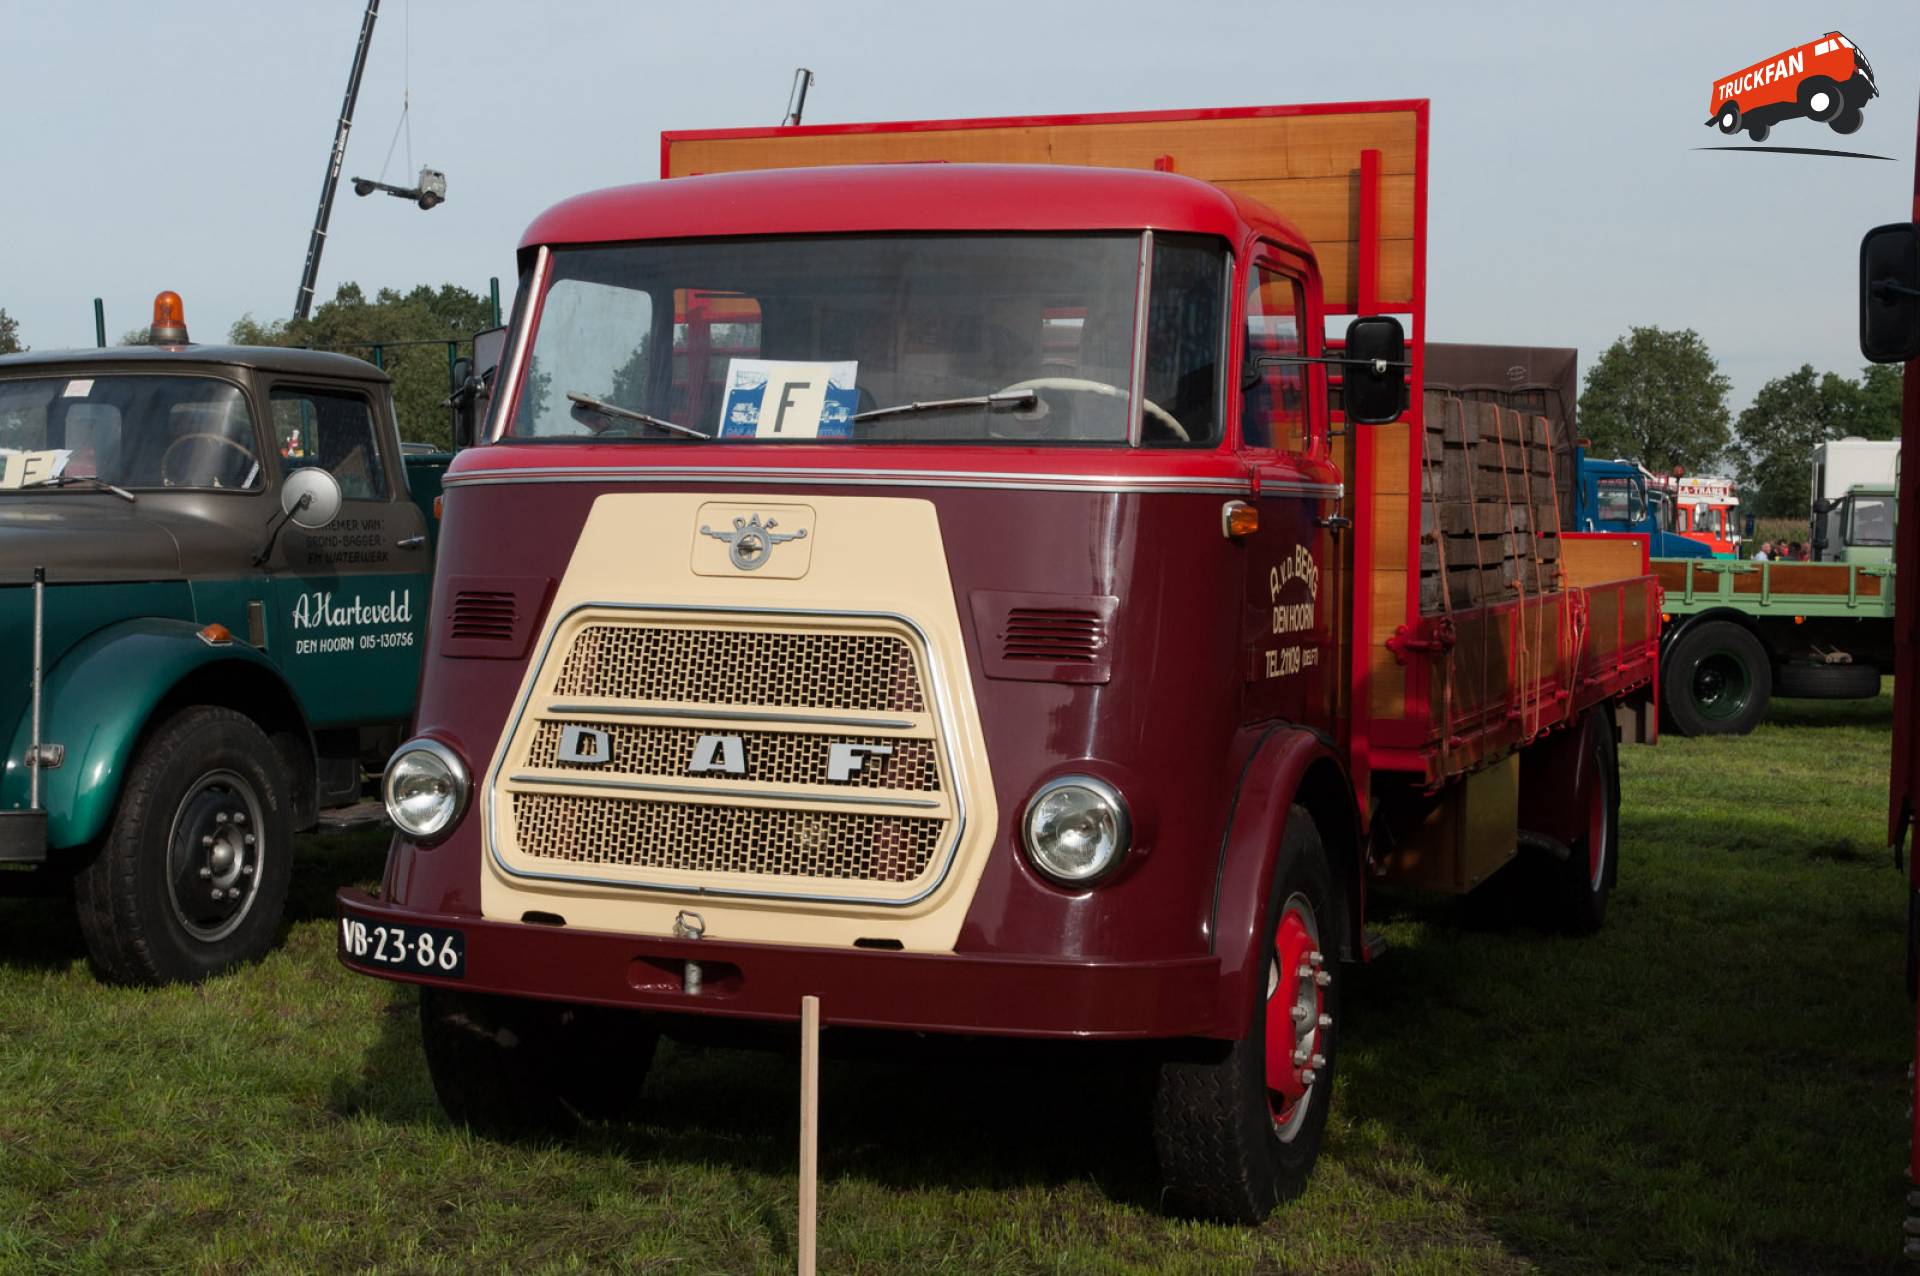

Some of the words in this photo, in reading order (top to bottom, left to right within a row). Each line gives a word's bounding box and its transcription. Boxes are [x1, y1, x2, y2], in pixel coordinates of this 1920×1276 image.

[774, 382, 811, 432] F
[22, 457, 42, 487] F
[733, 512, 778, 529] DAF
[325, 550, 389, 563] WATERWERK
[1295, 544, 1319, 600] BERG
[1273, 606, 1289, 634] DEN
[1289, 604, 1315, 632] HOORN
[296, 640, 318, 654] DEN
[320, 636, 354, 652] HOORN
[360, 632, 414, 649] 015-130756
[559, 724, 894, 781] DAF
[342, 918, 458, 970] VB-23-86
